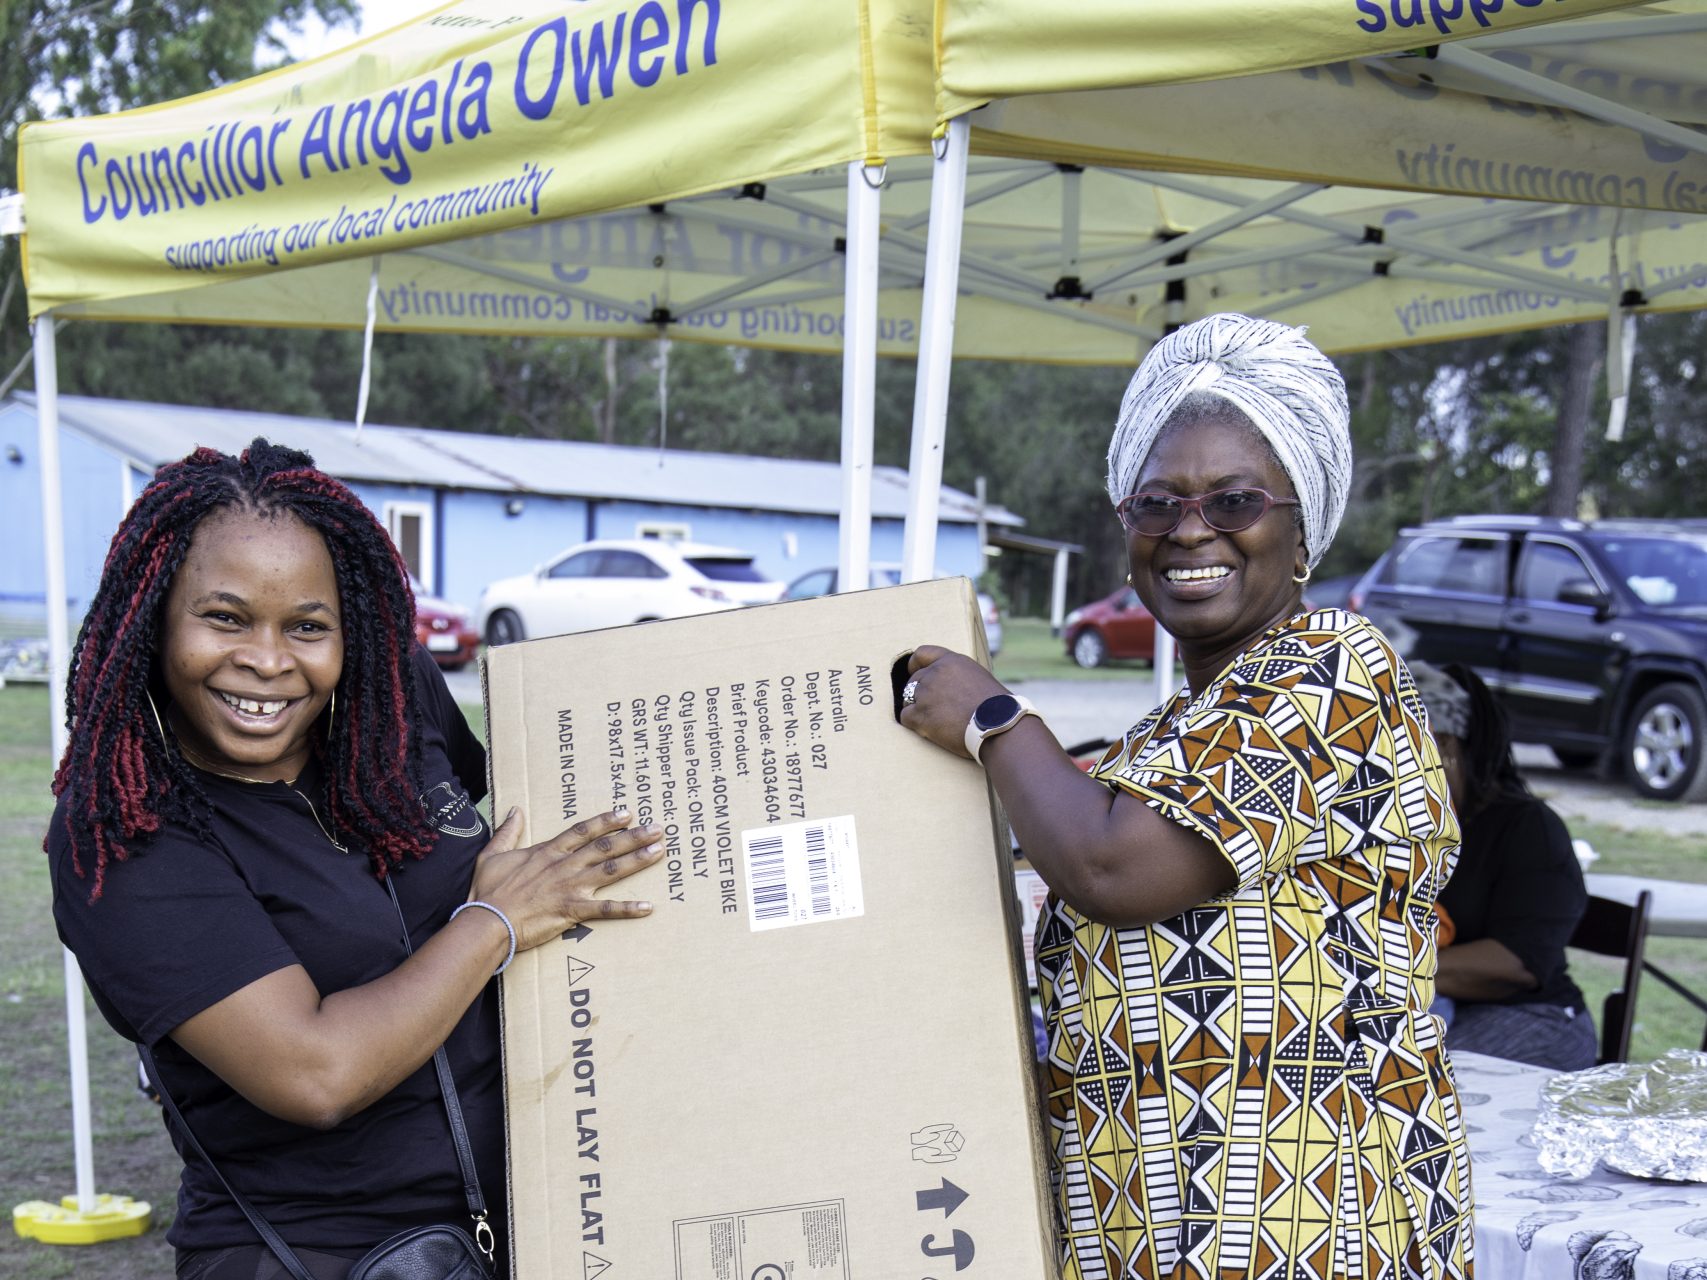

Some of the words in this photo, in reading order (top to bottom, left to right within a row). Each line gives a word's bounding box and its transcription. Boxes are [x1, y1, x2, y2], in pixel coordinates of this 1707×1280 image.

[76, 118, 292, 224] Councillor
[299, 58, 493, 185] Angela
[514, 0, 721, 121] Owen
[165, 223, 280, 274] supporting
[283, 216, 329, 254] our
[328, 195, 397, 245] local
[394, 162, 554, 232] community
[679, 691, 695, 718] Qty
[731, 683, 747, 716] Brief
[780, 676, 795, 716] Order
[804, 672, 820, 709] Dept.
[828, 669, 848, 732] Australia
[856, 664, 873, 706] ANKO
[632, 698, 647, 727] GRS
[654, 694, 671, 722] Qty
[754, 679, 771, 745] Keycode:
[808, 712, 824, 740] No.:
[558, 709, 574, 753] MADE
[683, 720, 697, 756] Issue
[705, 686, 722, 772] Description:
[733, 719, 750, 777] Product
[784, 719, 799, 747] No.:
[560, 754, 575, 769] IN
[656, 724, 674, 778] Shipper
[811, 744, 827, 770] 027
[635, 758, 651, 792] 11.60
[686, 759, 702, 798] Pack:
[761, 748, 781, 823] 43034604
[785, 751, 805, 818] 18977677
[561, 773, 577, 820] CHINA
[637, 795, 653, 826] KGS
[661, 780, 677, 821] Pack:
[688, 801, 704, 833] ONE
[712, 775, 729, 819] 40CM
[664, 824, 681, 856] ONE
[691, 836, 709, 878] ONLY
[715, 821, 734, 877] VIOLET
[667, 860, 685, 902] ONLY
[720, 879, 737, 914] BIKE
[569, 988, 592, 1028] DO
[572, 1037, 596, 1097] NOT
[576, 1107, 599, 1162] LAY
[579, 1172, 604, 1246] FLAT
